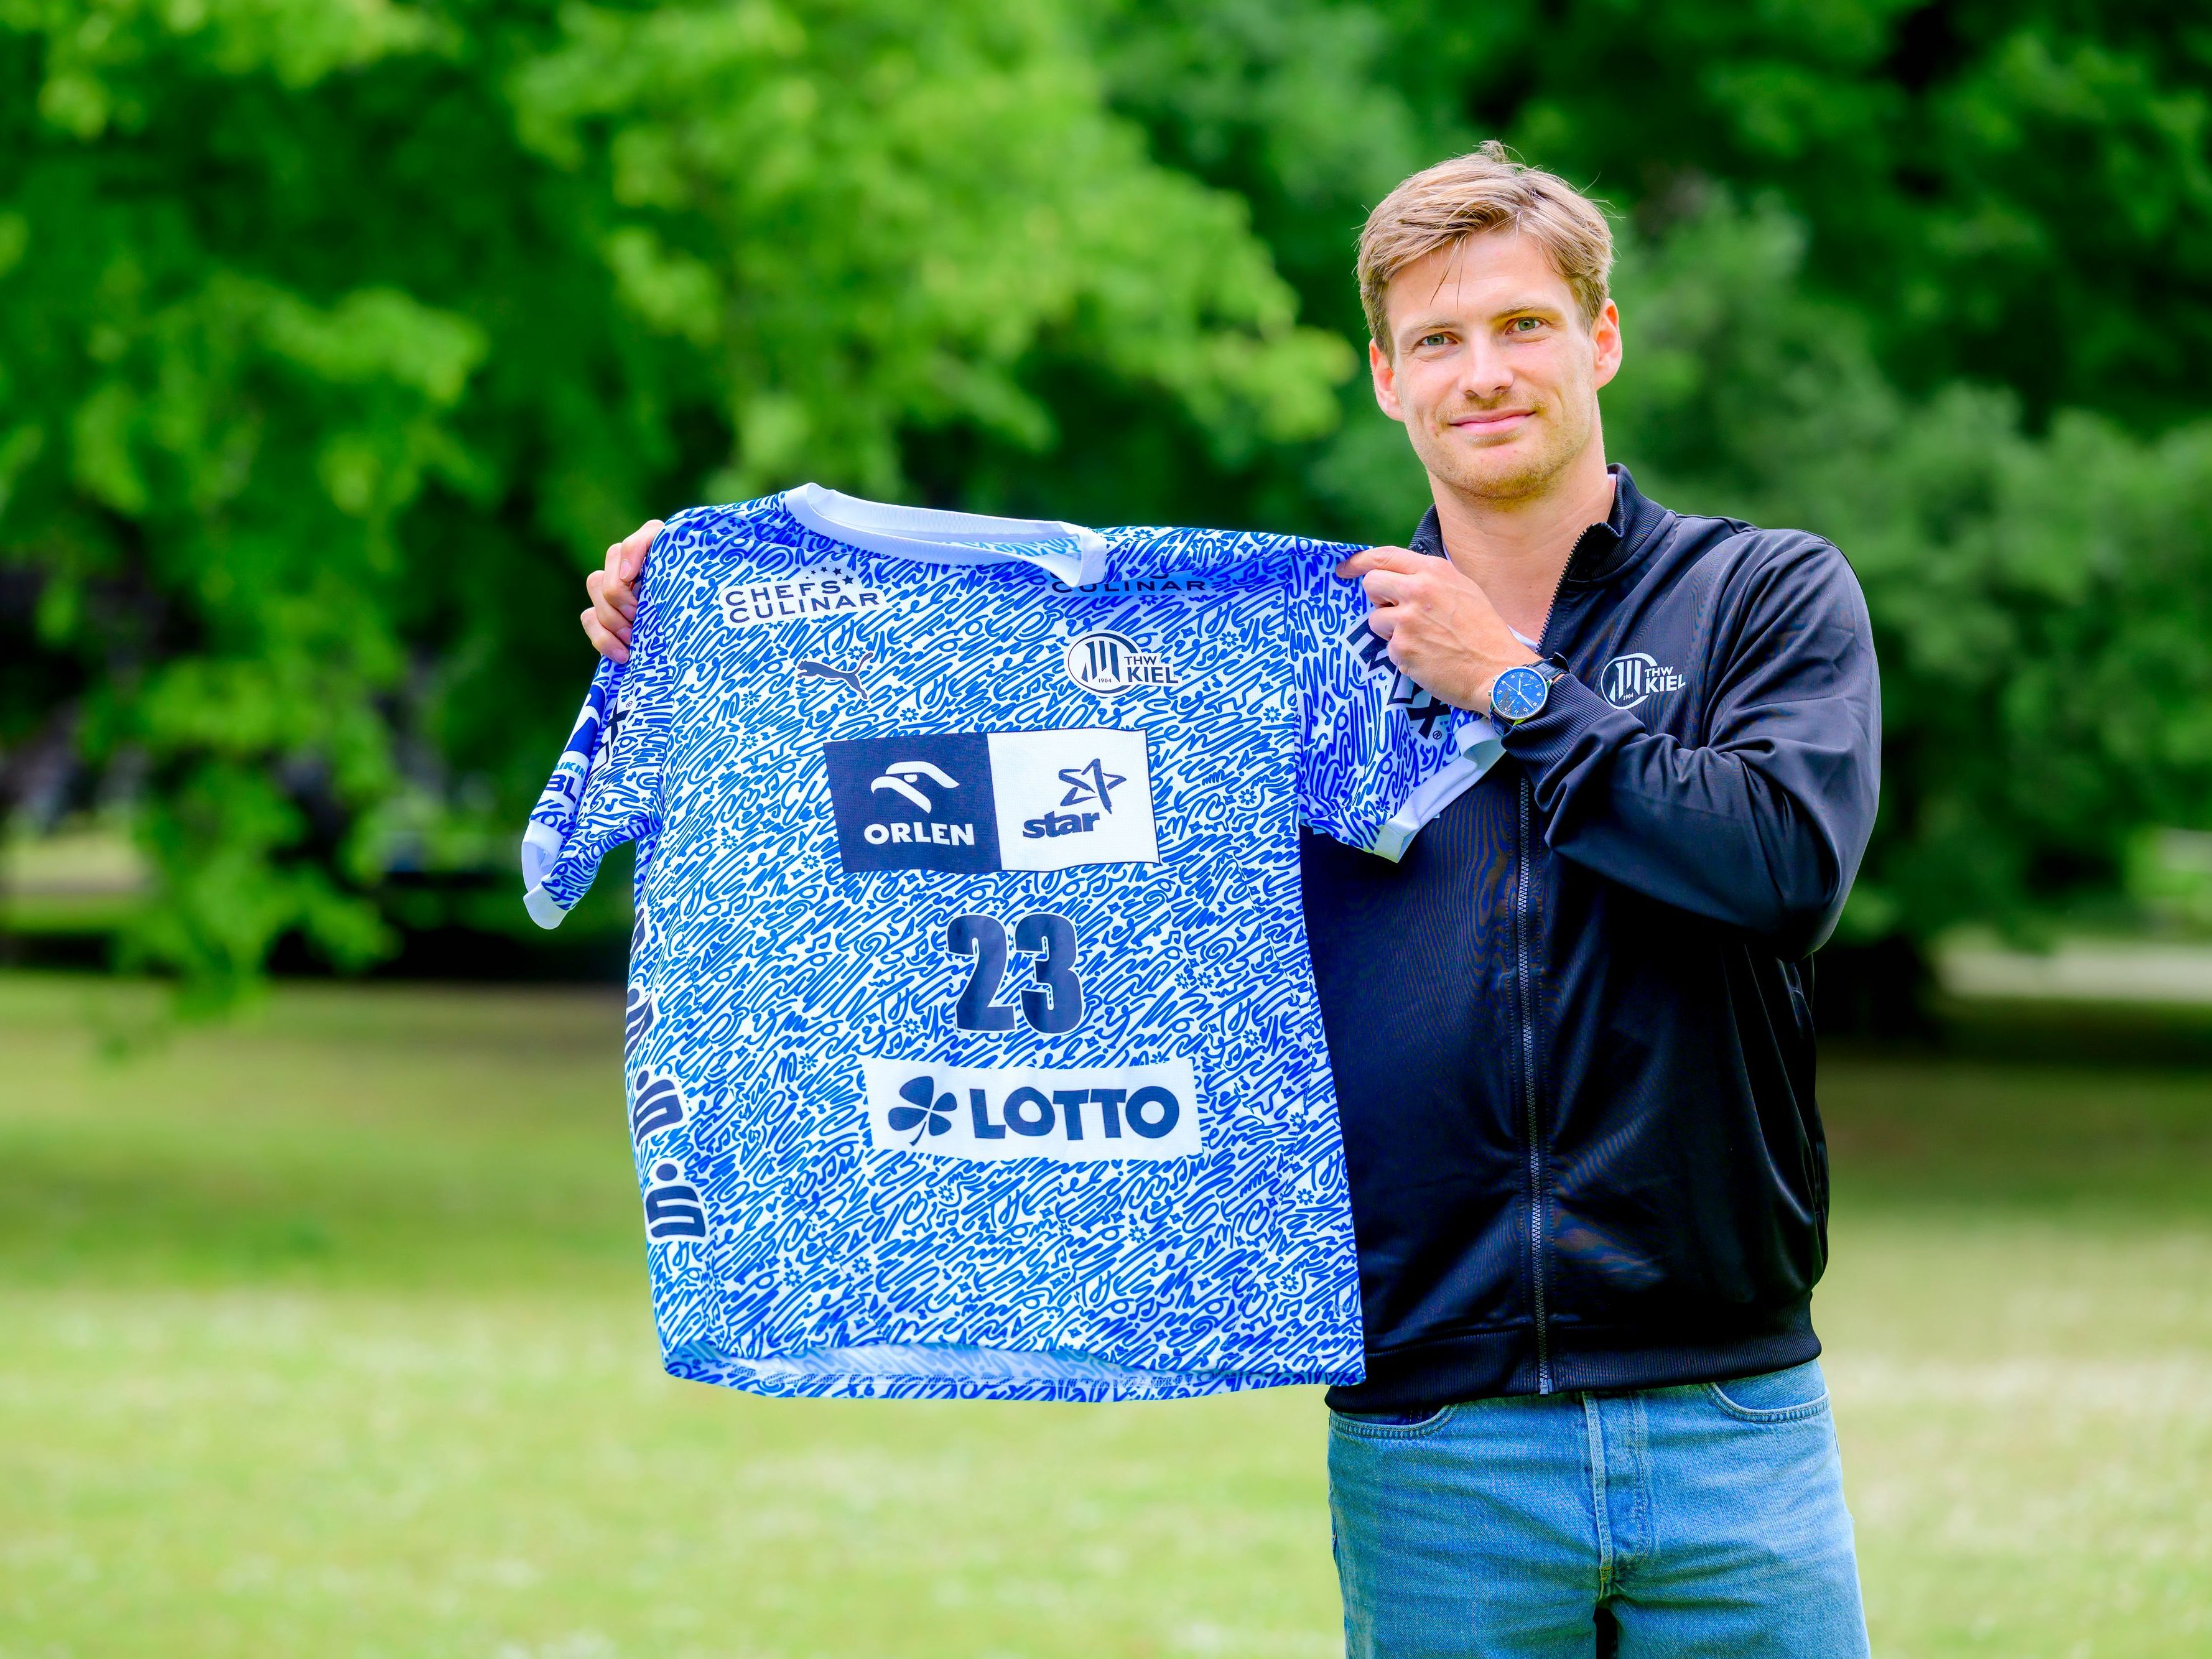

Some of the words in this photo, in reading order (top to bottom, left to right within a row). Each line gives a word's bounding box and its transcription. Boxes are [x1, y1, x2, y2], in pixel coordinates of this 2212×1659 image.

[725, 580, 841, 606] CHEFS
[730, 593, 880, 623] CULINAR
[1124, 656, 1157, 665] THW
[1644, 666, 1673, 678] THW
[1127, 666, 1179, 684] KIEL
[1645, 674, 1686, 694] KIEL
[1623, 692, 1634, 700] 1904
[545, 774, 577, 804] BL
[863, 822, 975, 846] ORLEN
[1023, 811, 1100, 839] star
[947, 913, 1083, 1034] 23
[970, 1085, 1179, 1141] LOTTO
